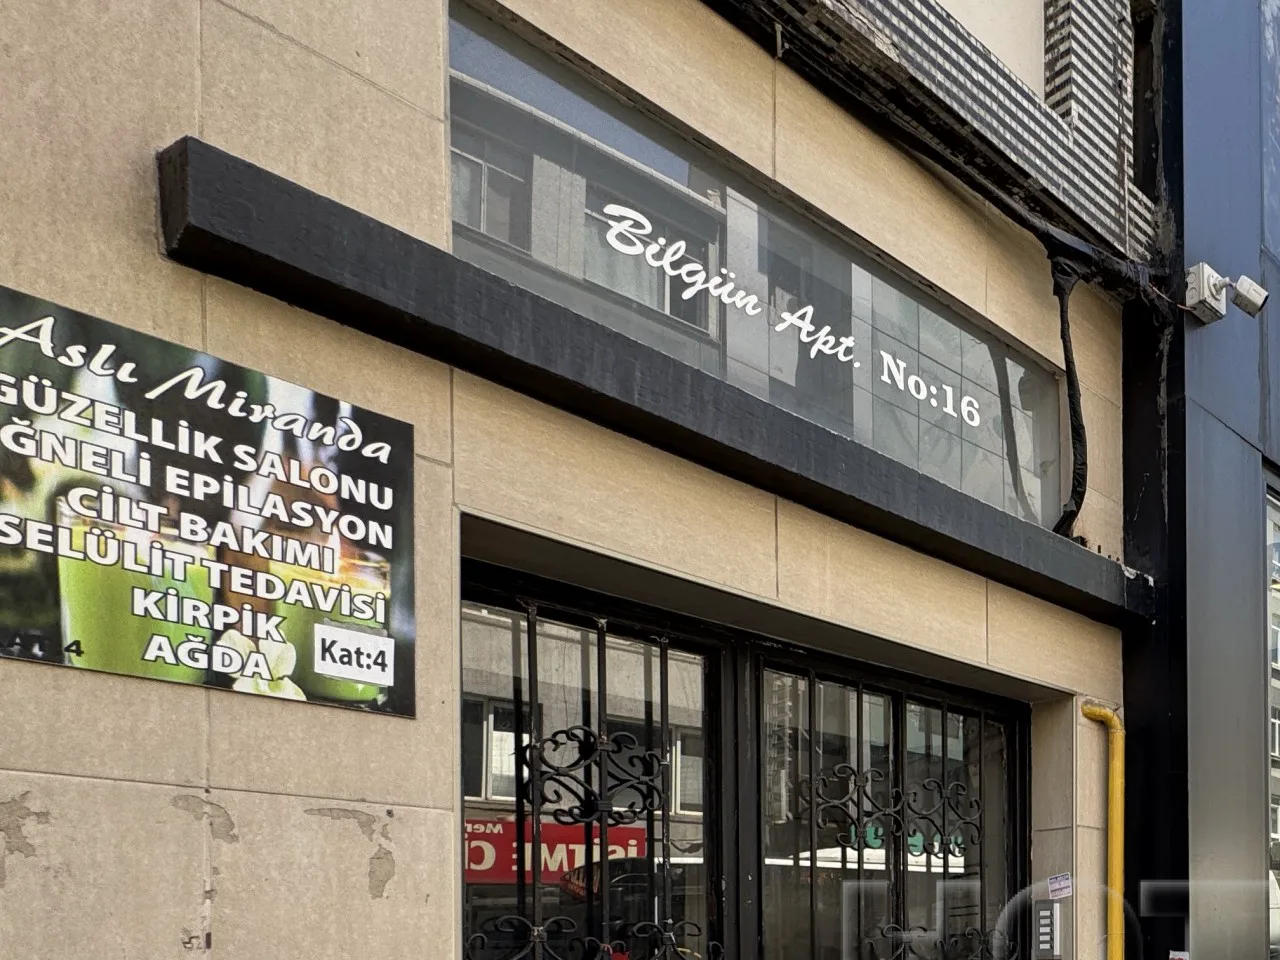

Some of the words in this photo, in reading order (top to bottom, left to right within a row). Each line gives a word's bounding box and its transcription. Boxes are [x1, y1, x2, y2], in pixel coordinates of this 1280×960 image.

[603, 204, 762, 316] Bilgün
[775, 305, 861, 368] Apt.
[880, 350, 981, 427] No:16
[0, 316, 139, 384] Aslı
[144, 366, 392, 465] Miranda
[0, 417, 152, 487] ĞNELİ
[165, 465, 393, 550] EPİLASYON
[233, 443, 394, 511] SALONU
[0, 515, 197, 580] SELÜLİT
[201, 558, 387, 624] TEDAVİSİ
[67, 486, 169, 533] CİLT
[179, 512, 335, 575] BAKIMI
[132, 587, 287, 643] KİRPİK
[142, 634, 274, 681] AĞDA
[320, 639, 388, 673] Kat:4
